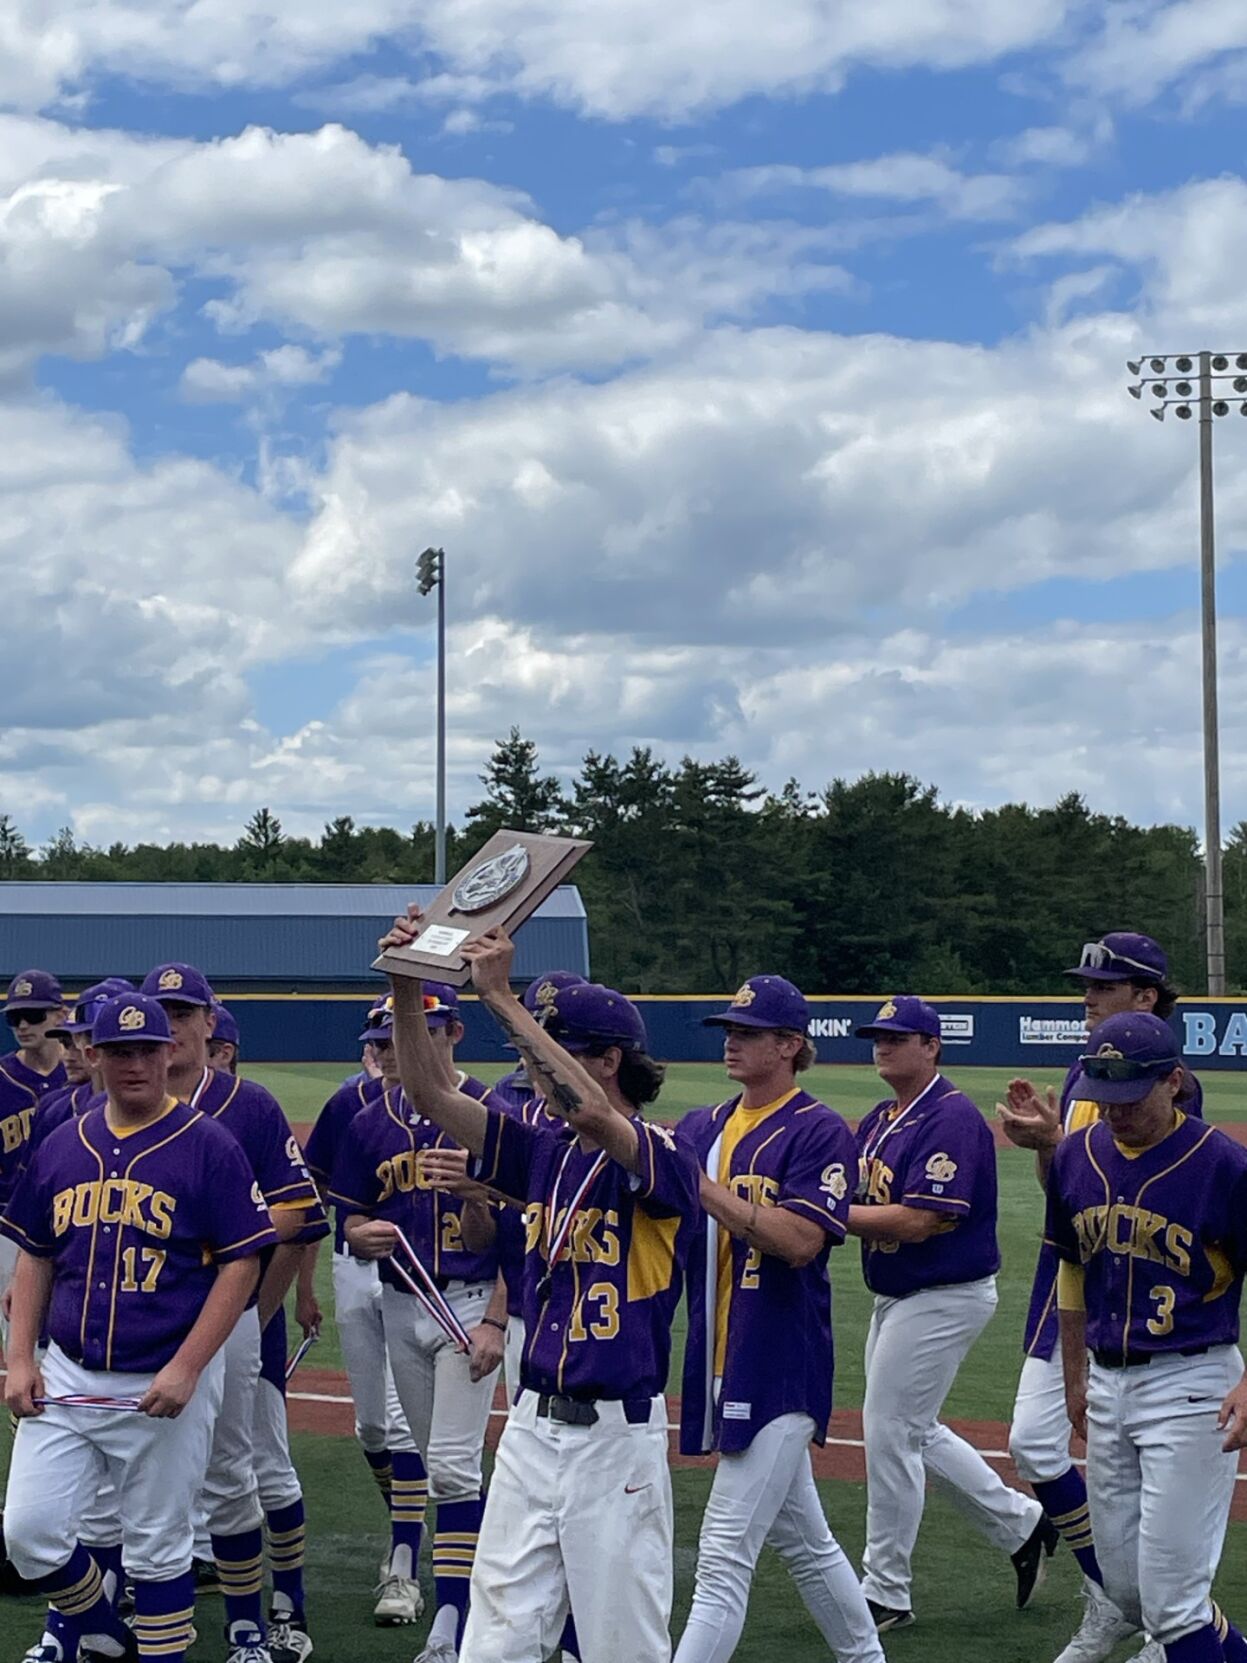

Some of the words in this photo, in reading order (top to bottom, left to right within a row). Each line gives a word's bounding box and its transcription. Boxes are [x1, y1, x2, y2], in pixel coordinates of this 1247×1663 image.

[53, 1179, 177, 1239] BUCKS
[120, 1246, 167, 1293] 17
[569, 1281, 620, 1342] 13
[1146, 1285, 1176, 1336] 3
